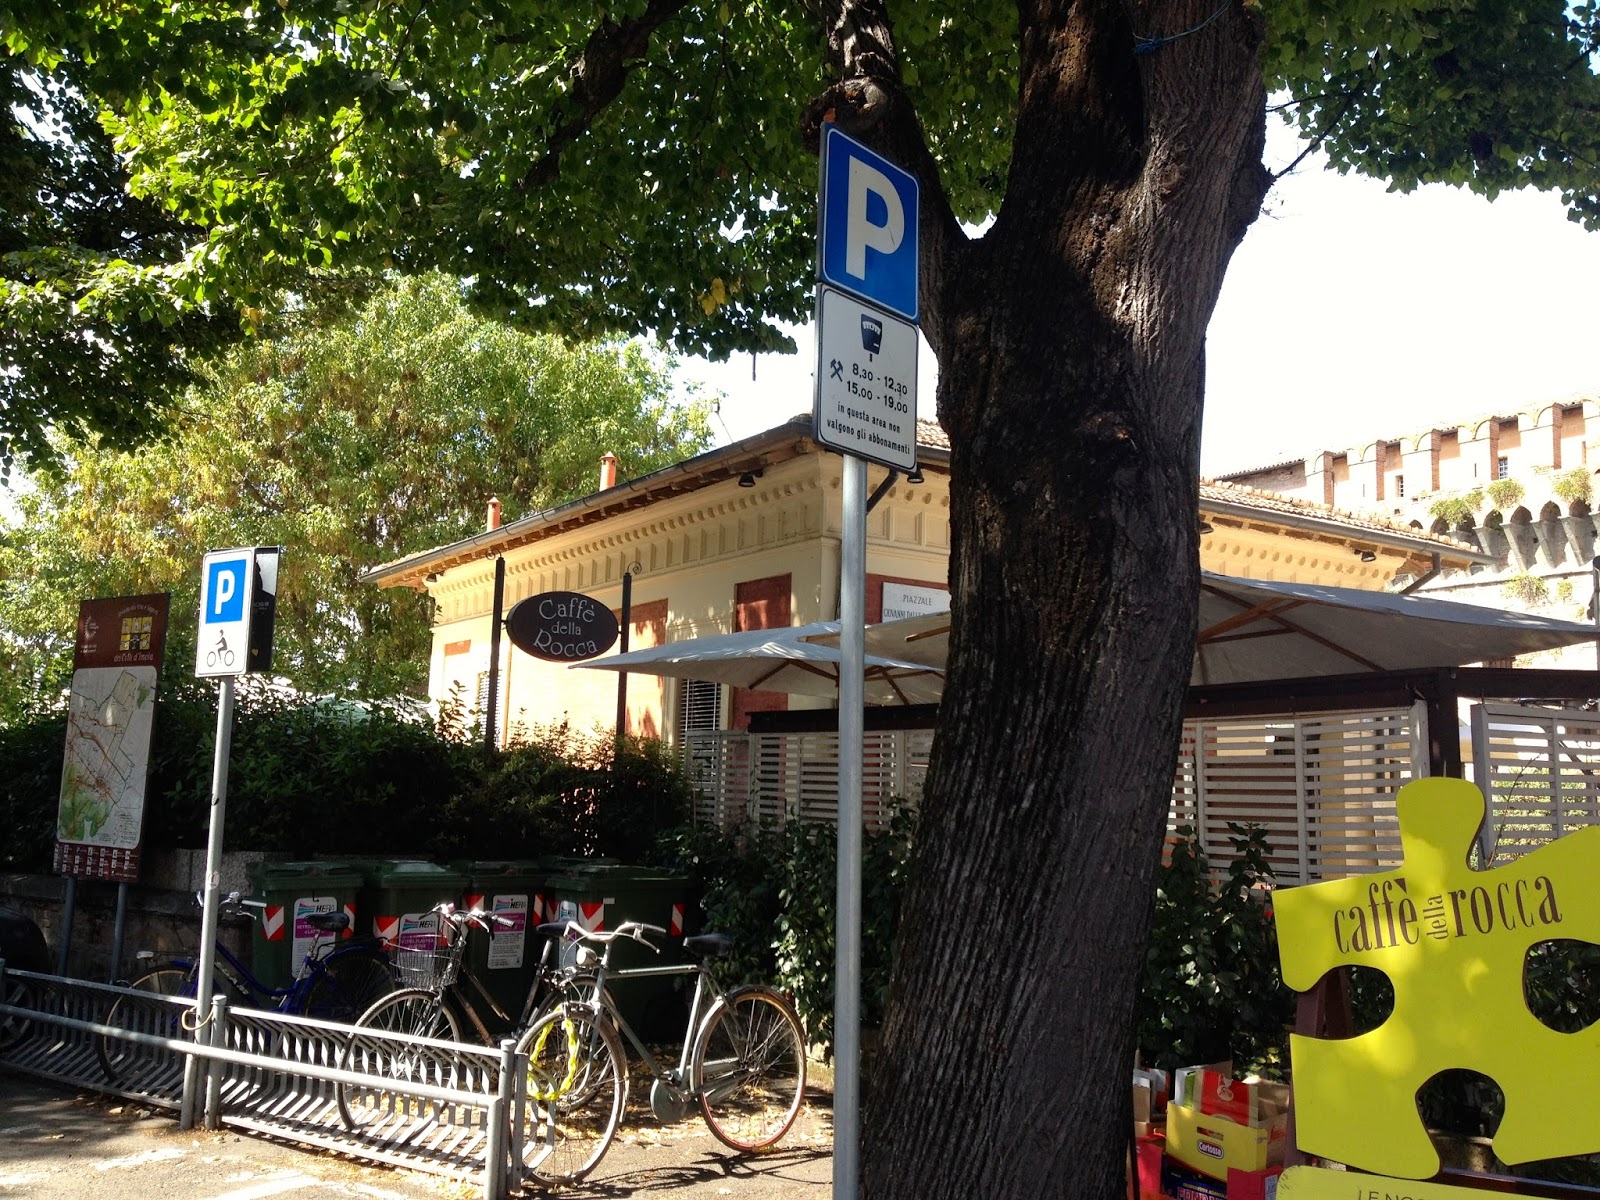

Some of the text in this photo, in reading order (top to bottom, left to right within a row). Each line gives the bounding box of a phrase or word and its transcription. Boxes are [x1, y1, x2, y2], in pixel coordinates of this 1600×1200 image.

[846, 154, 904, 280] P
[837, 401, 901, 433] in questa area non
[826, 419, 910, 454] valgono gli abbonamenti
[214, 569, 236, 615] P
[903, 594, 932, 605] PIAZZALE
[539, 597, 595, 622] Caffè
[883, 608, 906, 619] GIOVANNI
[533, 628, 598, 657] Rocca
[551, 621, 581, 636] della
[1333, 875, 1563, 955] caffè della rocca
